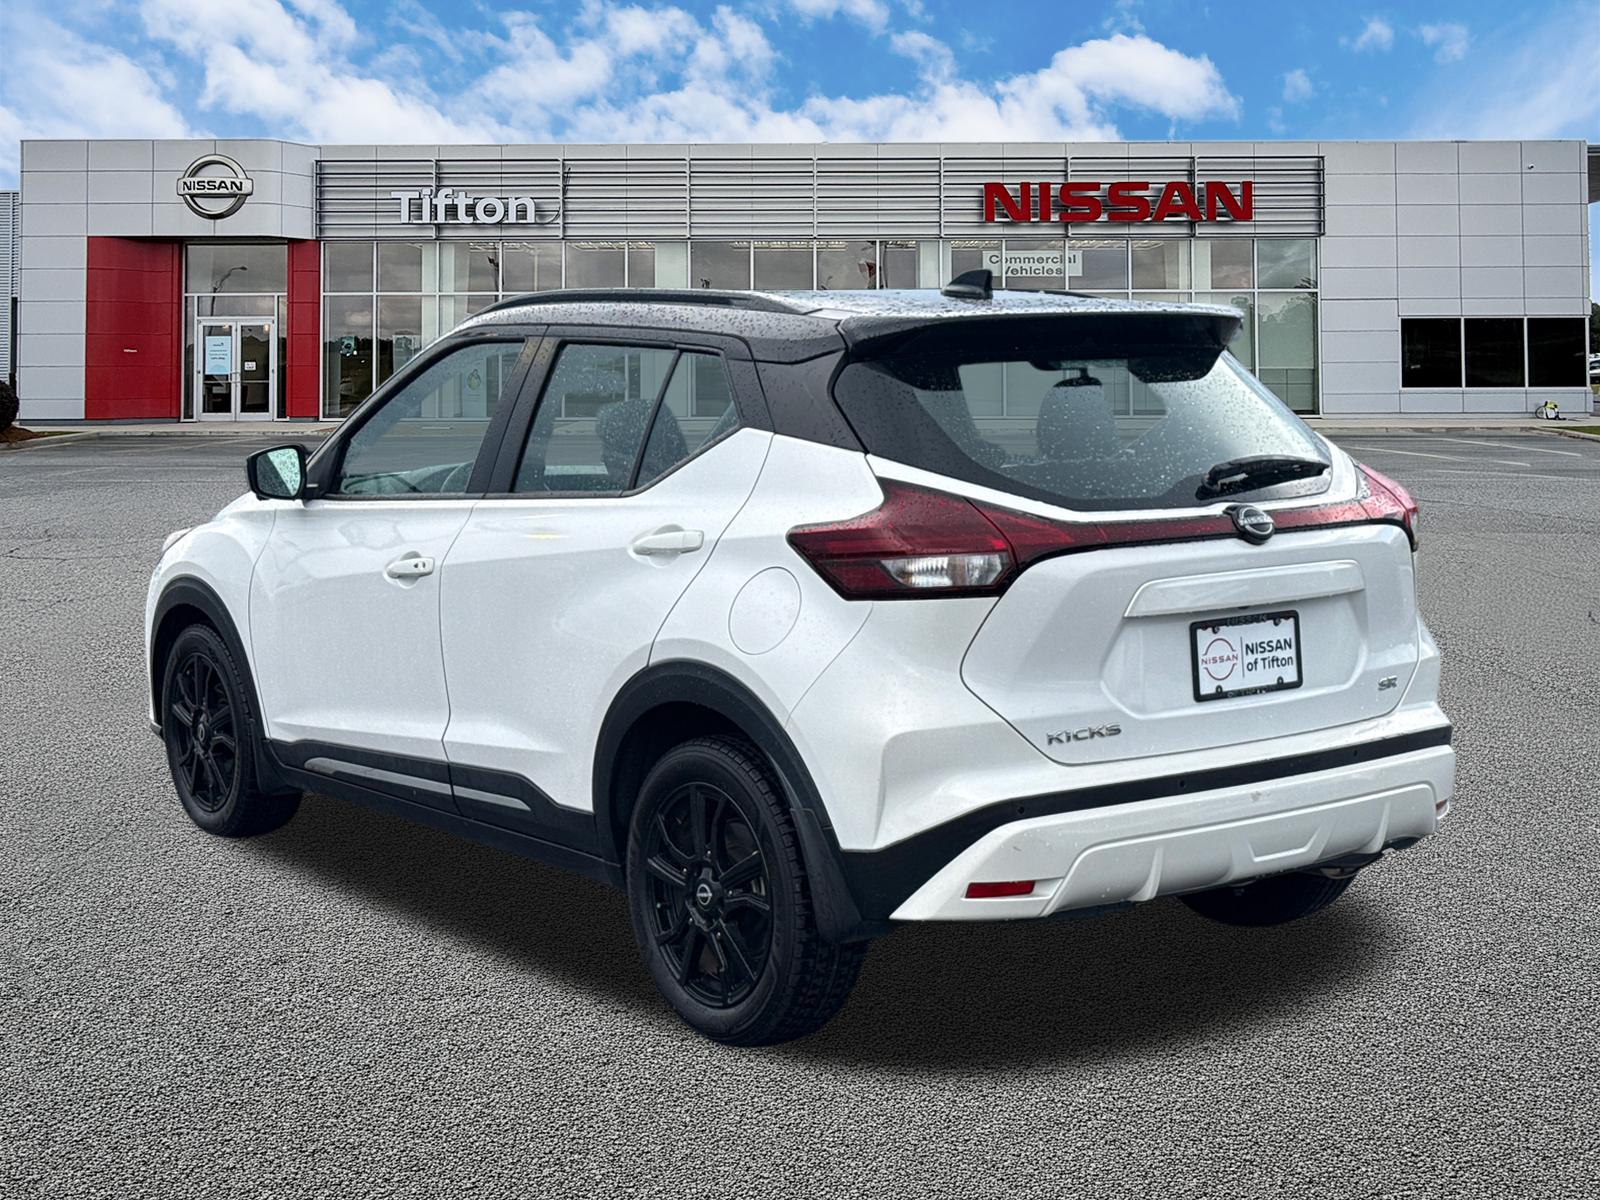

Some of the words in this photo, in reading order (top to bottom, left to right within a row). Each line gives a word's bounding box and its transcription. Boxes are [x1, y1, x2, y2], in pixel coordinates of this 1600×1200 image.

[182, 180, 243, 192] NISSAN
[391, 187, 536, 224] Tifton
[983, 181, 1253, 222] NISSAN
[988, 254, 1077, 265] Cmmercil
[1245, 637, 1293, 656] NISSAN
[1200, 653, 1239, 666] NISSAN
[1246, 657, 1259, 672] of
[1260, 655, 1294, 670] Tifton
[1377, 675, 1398, 691] SR
